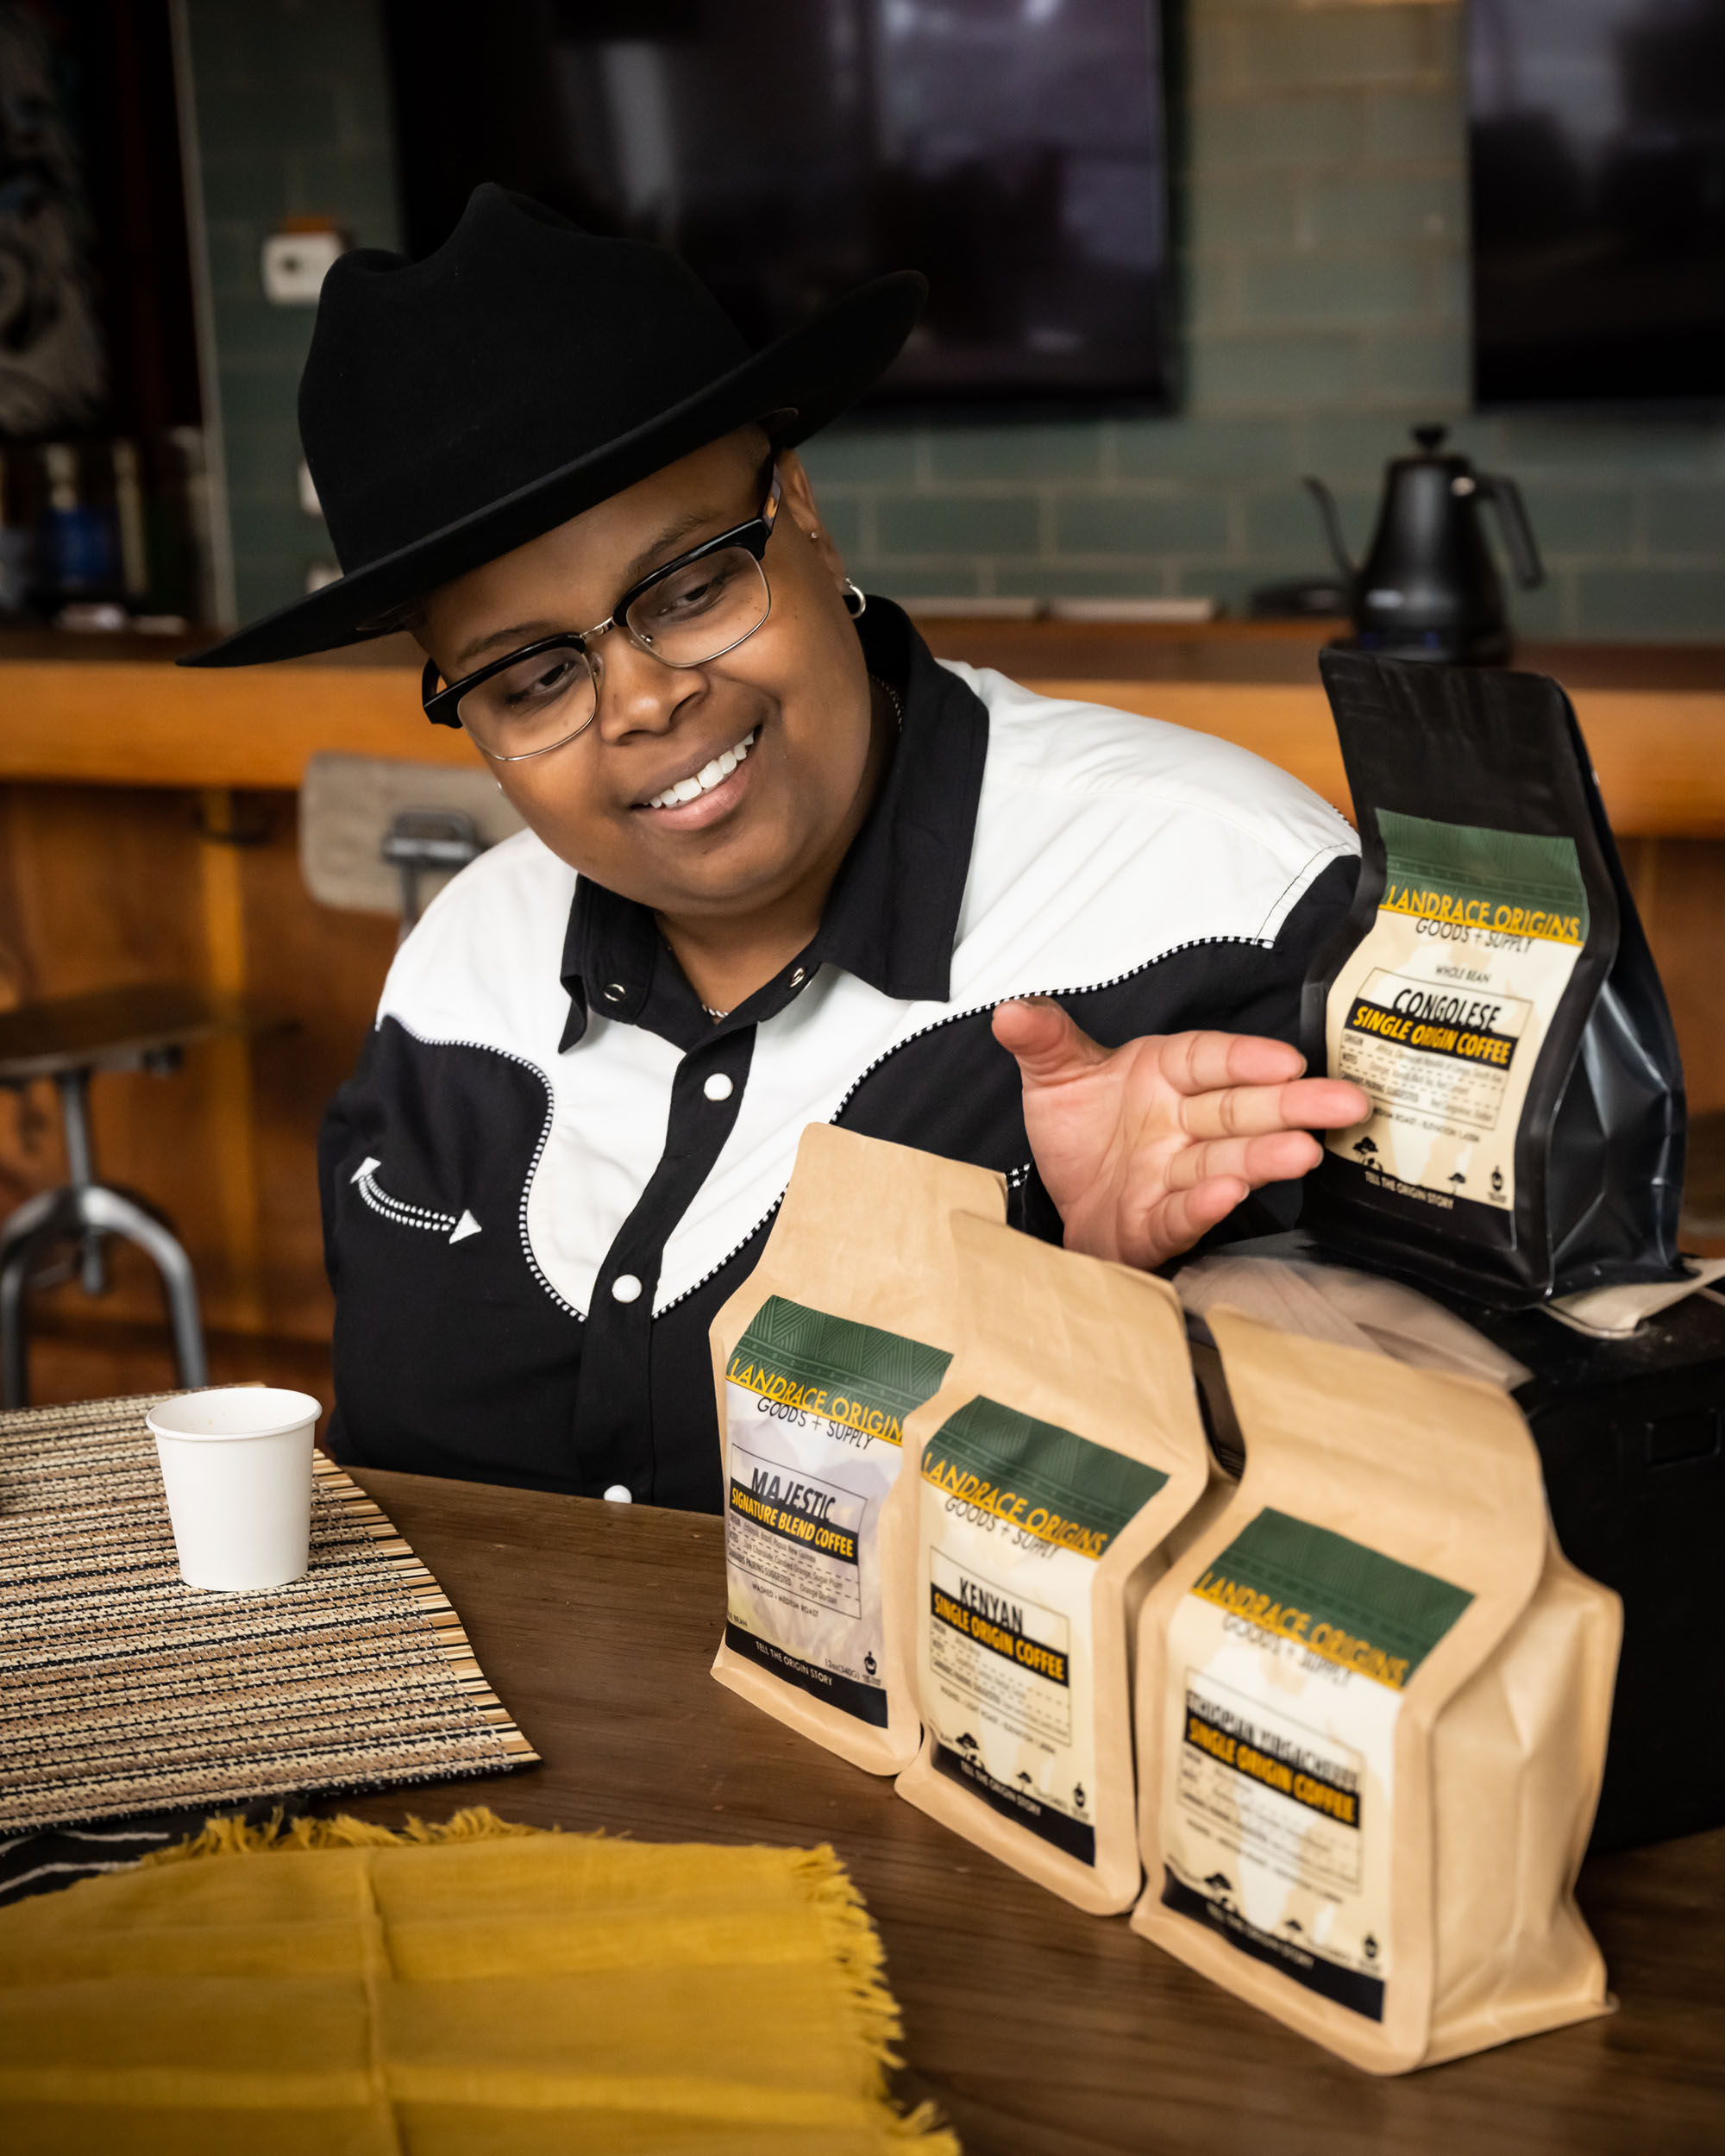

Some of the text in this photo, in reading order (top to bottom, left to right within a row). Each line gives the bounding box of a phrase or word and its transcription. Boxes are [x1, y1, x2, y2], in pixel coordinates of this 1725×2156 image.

[1386, 886, 1580, 940] LANDRACE ORIGINS
[1415, 919, 1469, 943] GOODS
[1485, 931, 1534, 953] SUPPLY
[1435, 965, 1493, 984] WHOLE BEAN
[1352, 1006, 1410, 1040] SINGLE
[1411, 1025, 1458, 1052] ORIGIN
[1457, 1035, 1512, 1064] COFFEE
[1393, 988, 1502, 1030] CONGOLESE
[1381, 1176, 1397, 1191] THE
[1397, 1182, 1427, 1200] ORIGIN
[1427, 1193, 1455, 1209] STORY
[731, 1358, 903, 1440] LANDRACE ORIGIN
[756, 1397, 807, 1428] GOODS
[826, 1420, 875, 1451] SUPPLY
[731, 1487, 854, 1557] SIGNATURE BLEND COFFEE
[750, 1468, 837, 1522] MAJESTIC
[924, 1452, 1108, 1555] LANDRACE ORIGINS
[944, 1496, 999, 1532] GOODS
[1012, 1526, 1063, 1559] SUPPLY
[752, 1583, 774, 1597] WASHED
[801, 1603, 819, 1618] ROAST
[960, 1576, 1023, 1635] KENYAN
[1198, 1571, 1408, 1685] LANDRACE ORIGINS
[756, 1640, 833, 1686] TELL THE ORIGIN STORY
[934, 1592, 970, 1631] SINGLE
[970, 1614, 1014, 1656] ORIGIN
[1016, 1641, 1065, 1681] COFFEE
[1189, 1718, 1236, 1764] SINGLE
[1236, 1744, 1294, 1792] ORIGIN
[1293, 1773, 1356, 1822] COFFEE
